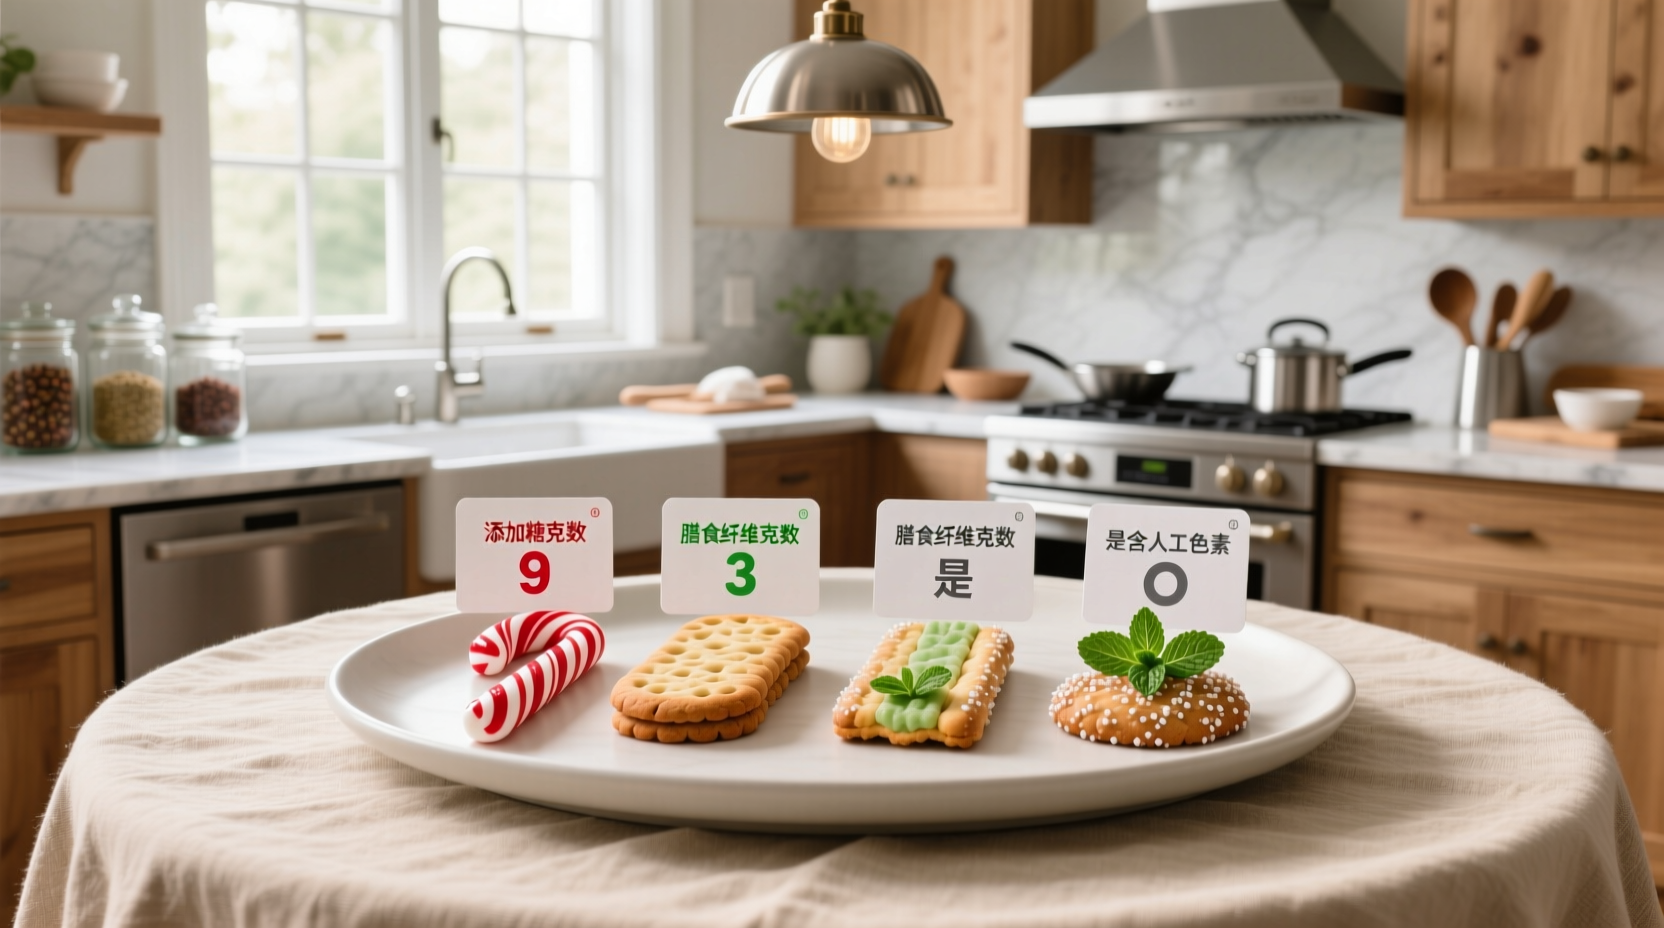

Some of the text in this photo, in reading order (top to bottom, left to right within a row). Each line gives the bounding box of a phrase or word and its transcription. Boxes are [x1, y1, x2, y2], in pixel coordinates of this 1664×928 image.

[484, 521, 586, 543] 添加糖克数
[681, 522, 799, 545] 膳食纤维克数
[895, 524, 1015, 549] 膳食纤维克数
[1105, 530, 1230, 556] 是含人工色素
[519, 550, 551, 595] 9
[725, 552, 757, 597] 3
[933, 558, 973, 599] 是
